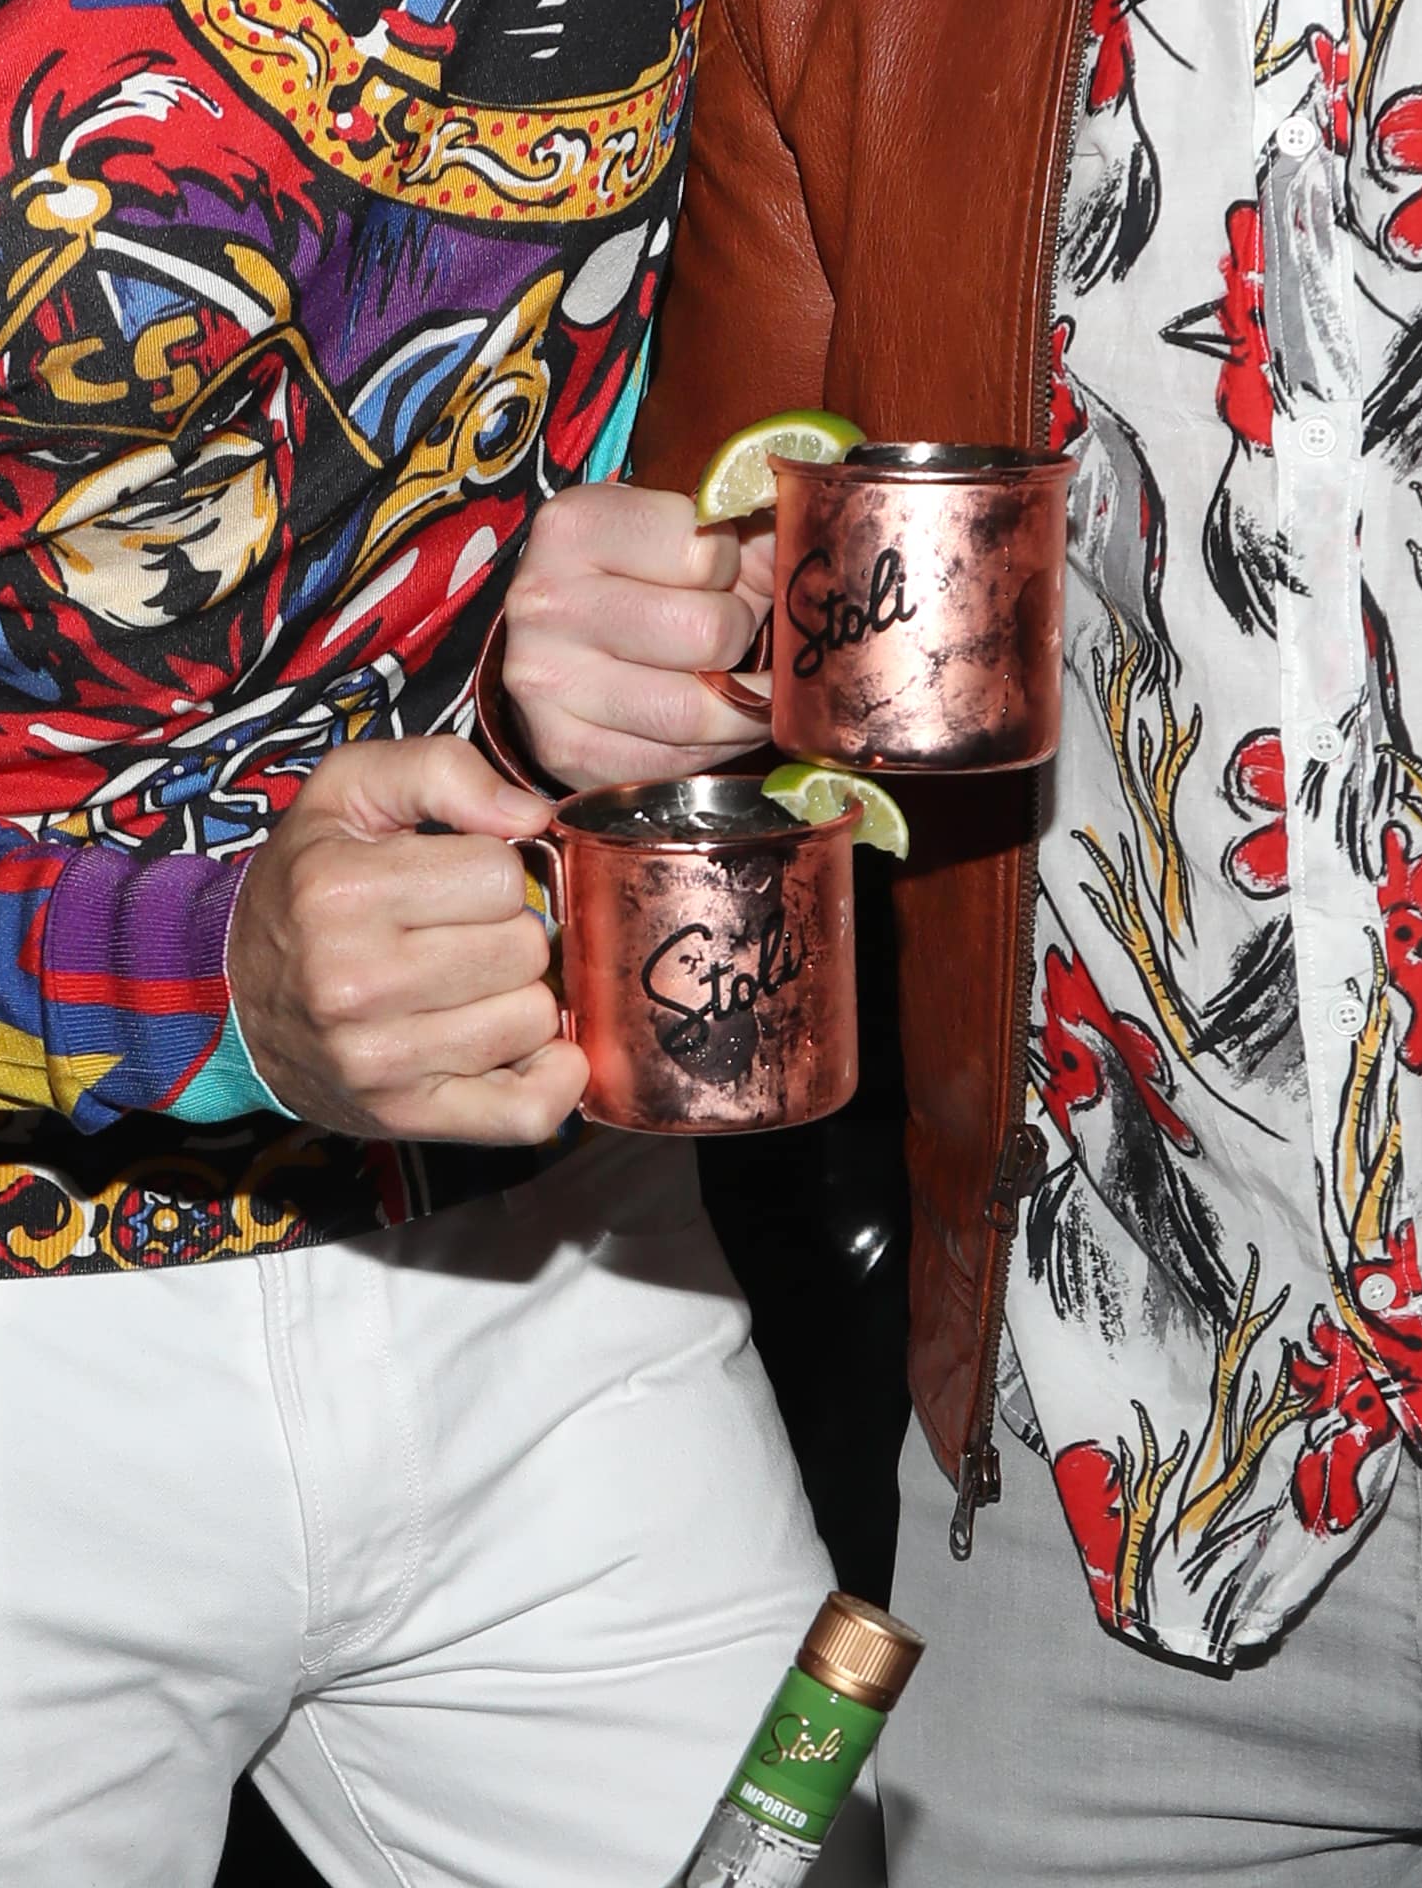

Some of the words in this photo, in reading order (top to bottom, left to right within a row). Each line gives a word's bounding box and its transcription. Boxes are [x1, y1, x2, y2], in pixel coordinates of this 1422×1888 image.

[786, 548, 918, 678] Stoli
[641, 922, 801, 1056] Stoli
[759, 1713, 844, 1765] Stoli
[739, 1781, 808, 1829] IMPORTED
